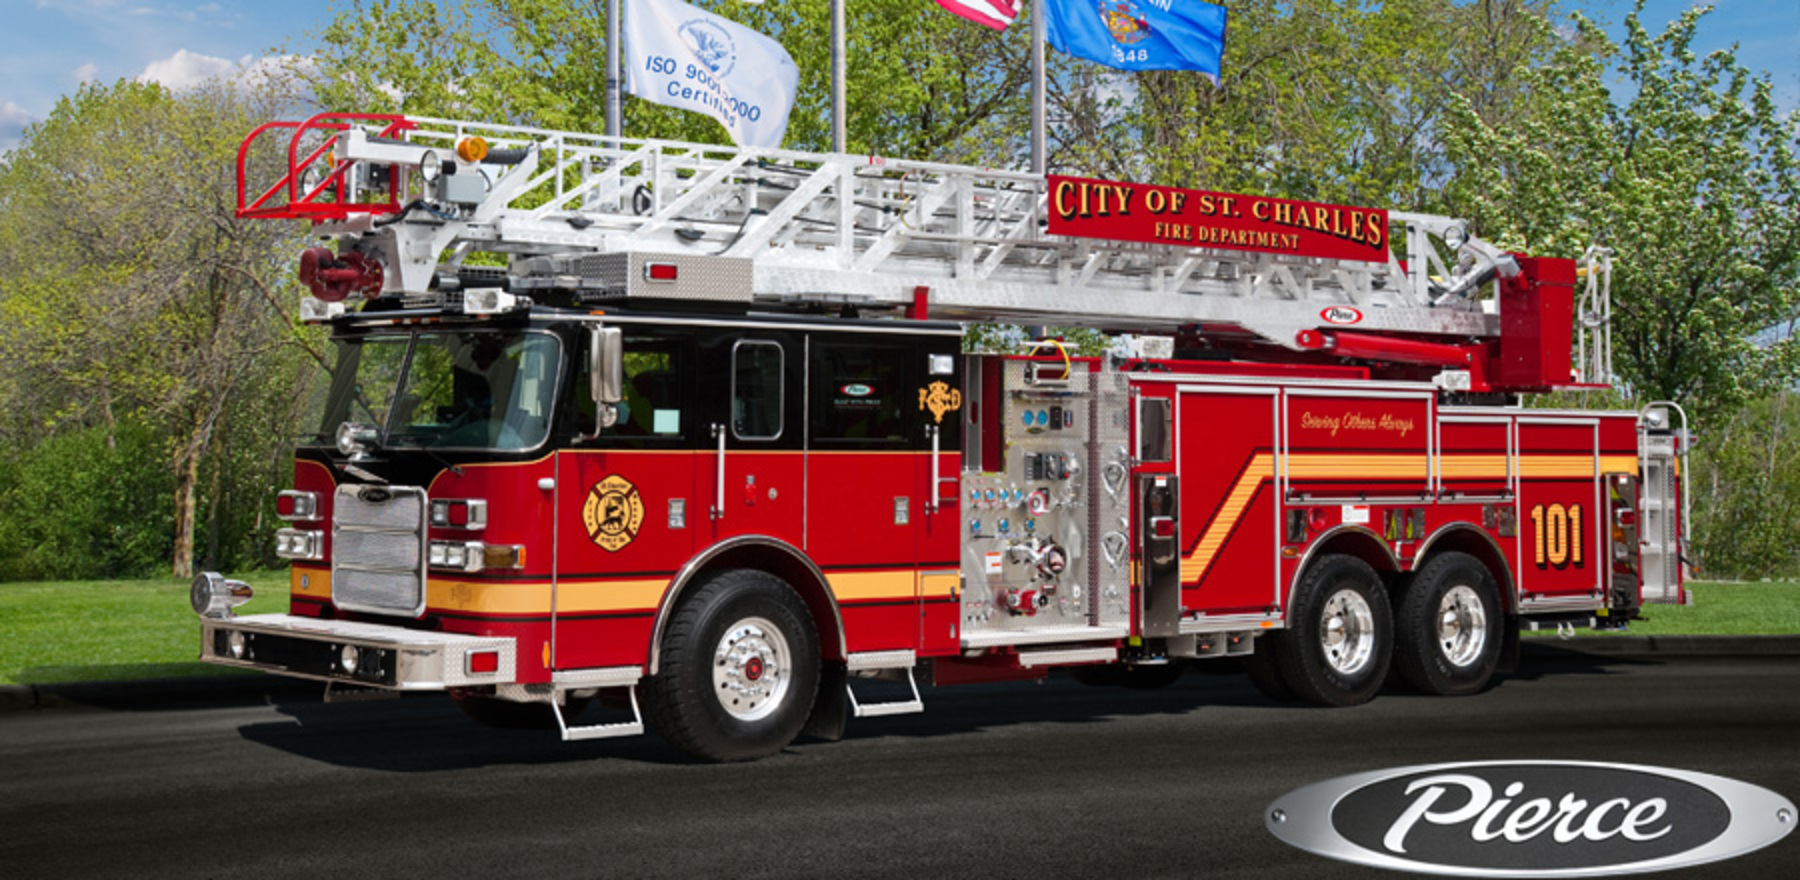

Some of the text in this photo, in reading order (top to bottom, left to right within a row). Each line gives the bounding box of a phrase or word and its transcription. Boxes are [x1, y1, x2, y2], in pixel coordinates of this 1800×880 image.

[645, 55, 761, 122] ISO 9001:000
[1055, 180, 1382, 250] CITY OF ST. CHARLES
[1155, 221, 1300, 250] FIRE DEPARTMENT
[1301, 411, 1340, 437] Serving
[1531, 503, 1584, 570] 101
